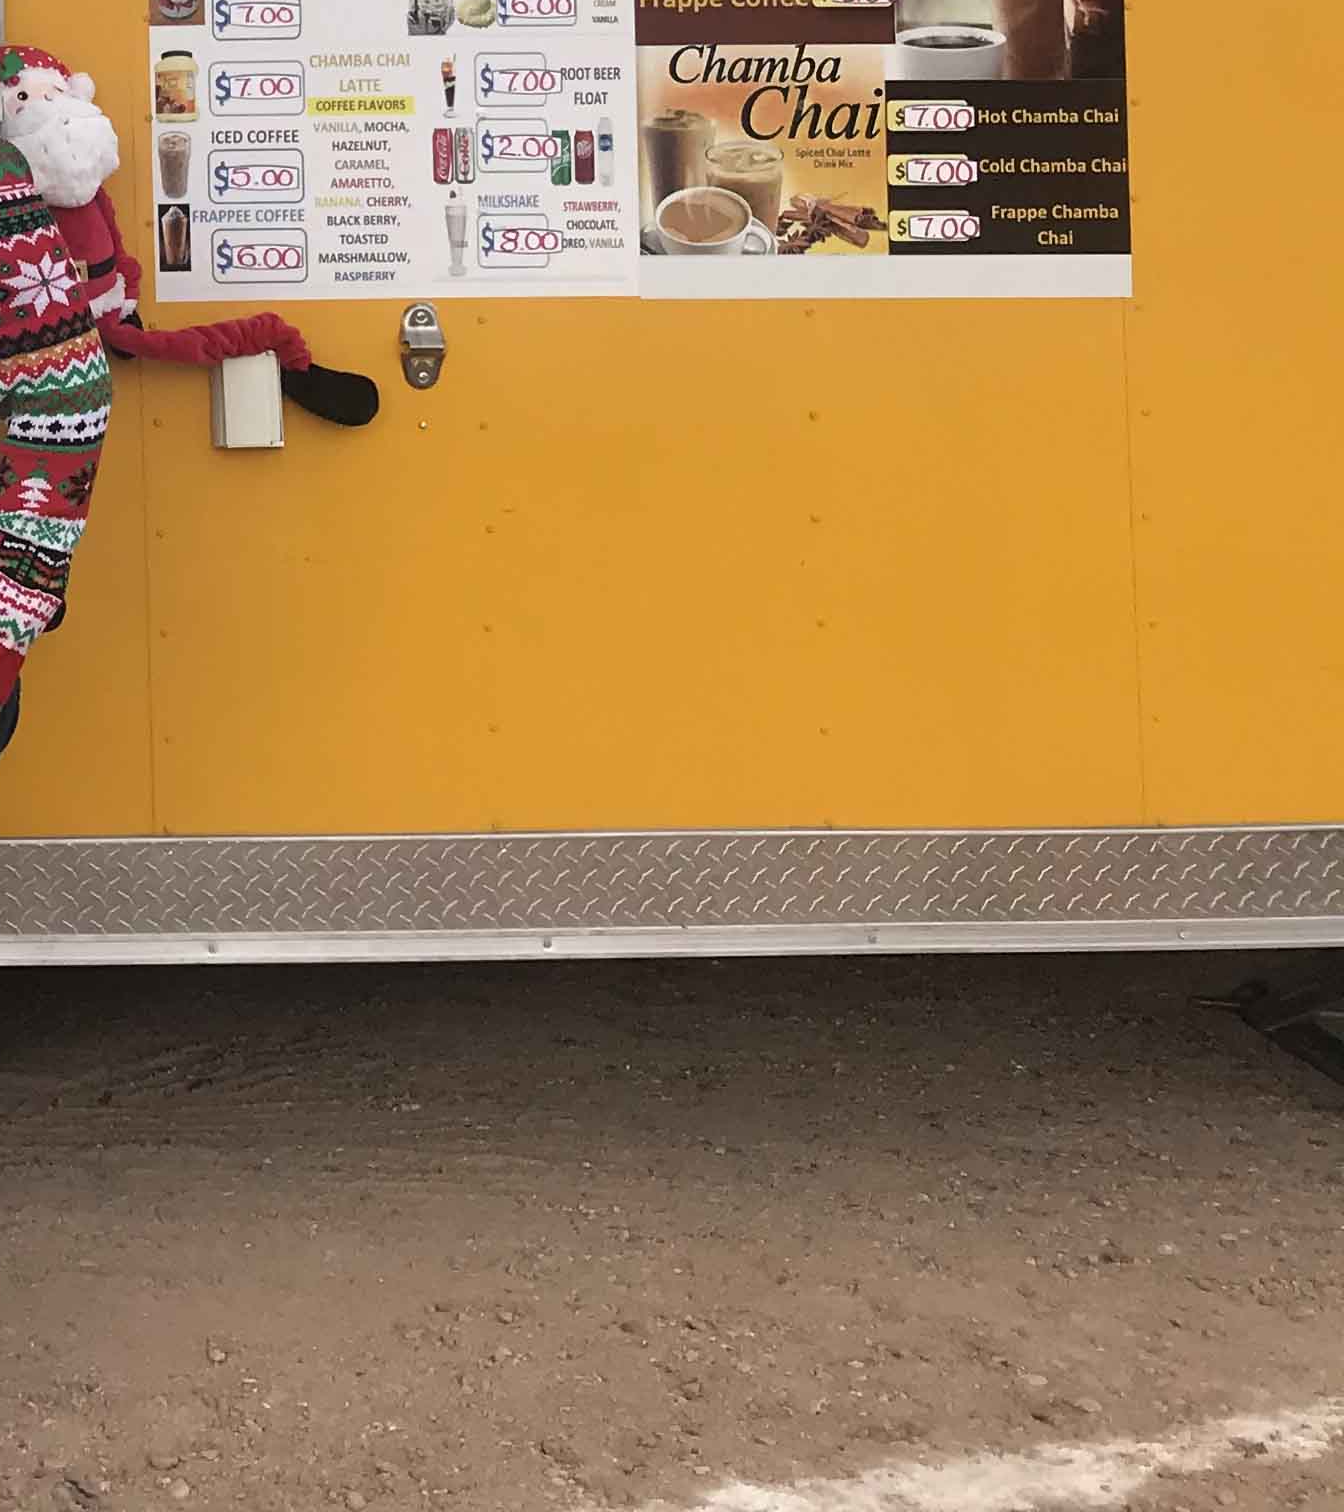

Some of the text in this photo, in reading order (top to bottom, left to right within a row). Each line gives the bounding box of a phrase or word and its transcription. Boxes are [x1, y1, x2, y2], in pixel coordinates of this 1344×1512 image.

[309, 53, 411, 68] CHAMBA CHAI
[668, 44, 841, 85] Chamba
[561, 67, 621, 80] ROOT BEER
[339, 79, 382, 92] LATTE
[574, 92, 608, 104] FLOAT
[316, 99, 406, 111] COFFEE FLAVORS
[740, 87, 884, 141] Chai
[978, 107, 1119, 124] Hot Chamba Chai
[313, 121, 410, 134] VANILLA, MOCHA,
[211, 129, 299, 144] ICED COFFEE
[332, 140, 391, 152] HAZELNUT,
[335, 159, 390, 171] CARAMEL,
[979, 157, 1126, 174] Cold Chamba Chai
[330, 177, 394, 189] AMARETTO,
[366, 196, 411, 208] CHERRY,
[478, 195, 539, 208] MILKSHAKE
[563, 201, 621, 213] STRAWBERRY,
[192, 209, 304, 223] FRAPPEE COFFEE
[991, 204, 1119, 223] Frappe Chamba
[327, 215, 400, 227] BLACK BERRY,
[566, 220, 618, 231] CHOCOLATE,
[340, 234, 388, 245] TOASTED
[562, 238, 624, 249] OREO, VANILLA
[1038, 231, 1073, 246] Chai
[318, 252, 411, 264] MARSHMALLOW,
[334, 271, 395, 281] RASPBERRY
